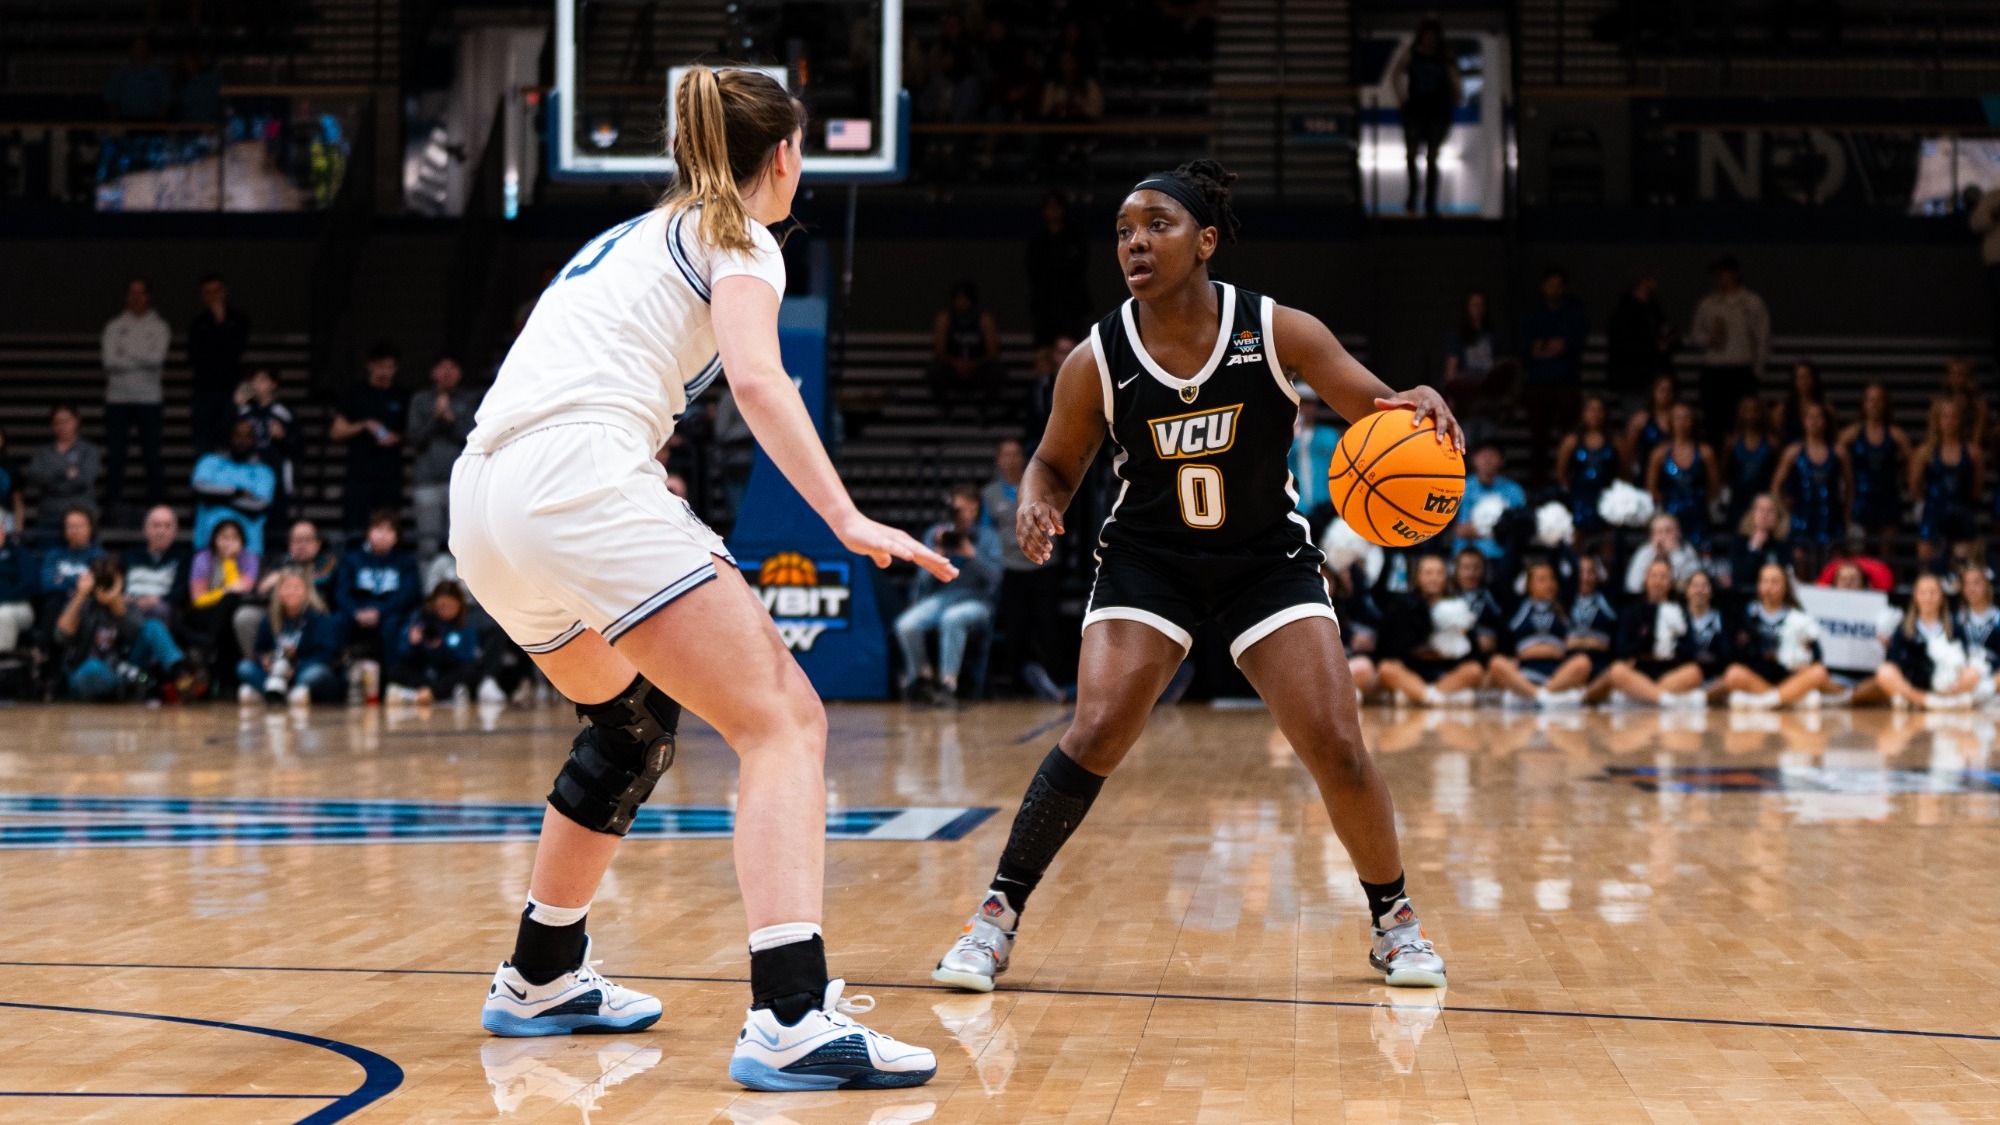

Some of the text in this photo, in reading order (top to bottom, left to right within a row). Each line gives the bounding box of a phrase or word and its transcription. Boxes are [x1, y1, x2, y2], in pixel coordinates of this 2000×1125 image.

[550, 215, 648, 287] 3
[1233, 337, 1261, 346] WBIT
[1154, 410, 1235, 456] VCU
[1177, 463, 1226, 530] 0
[1424, 493, 1461, 514] CAA
